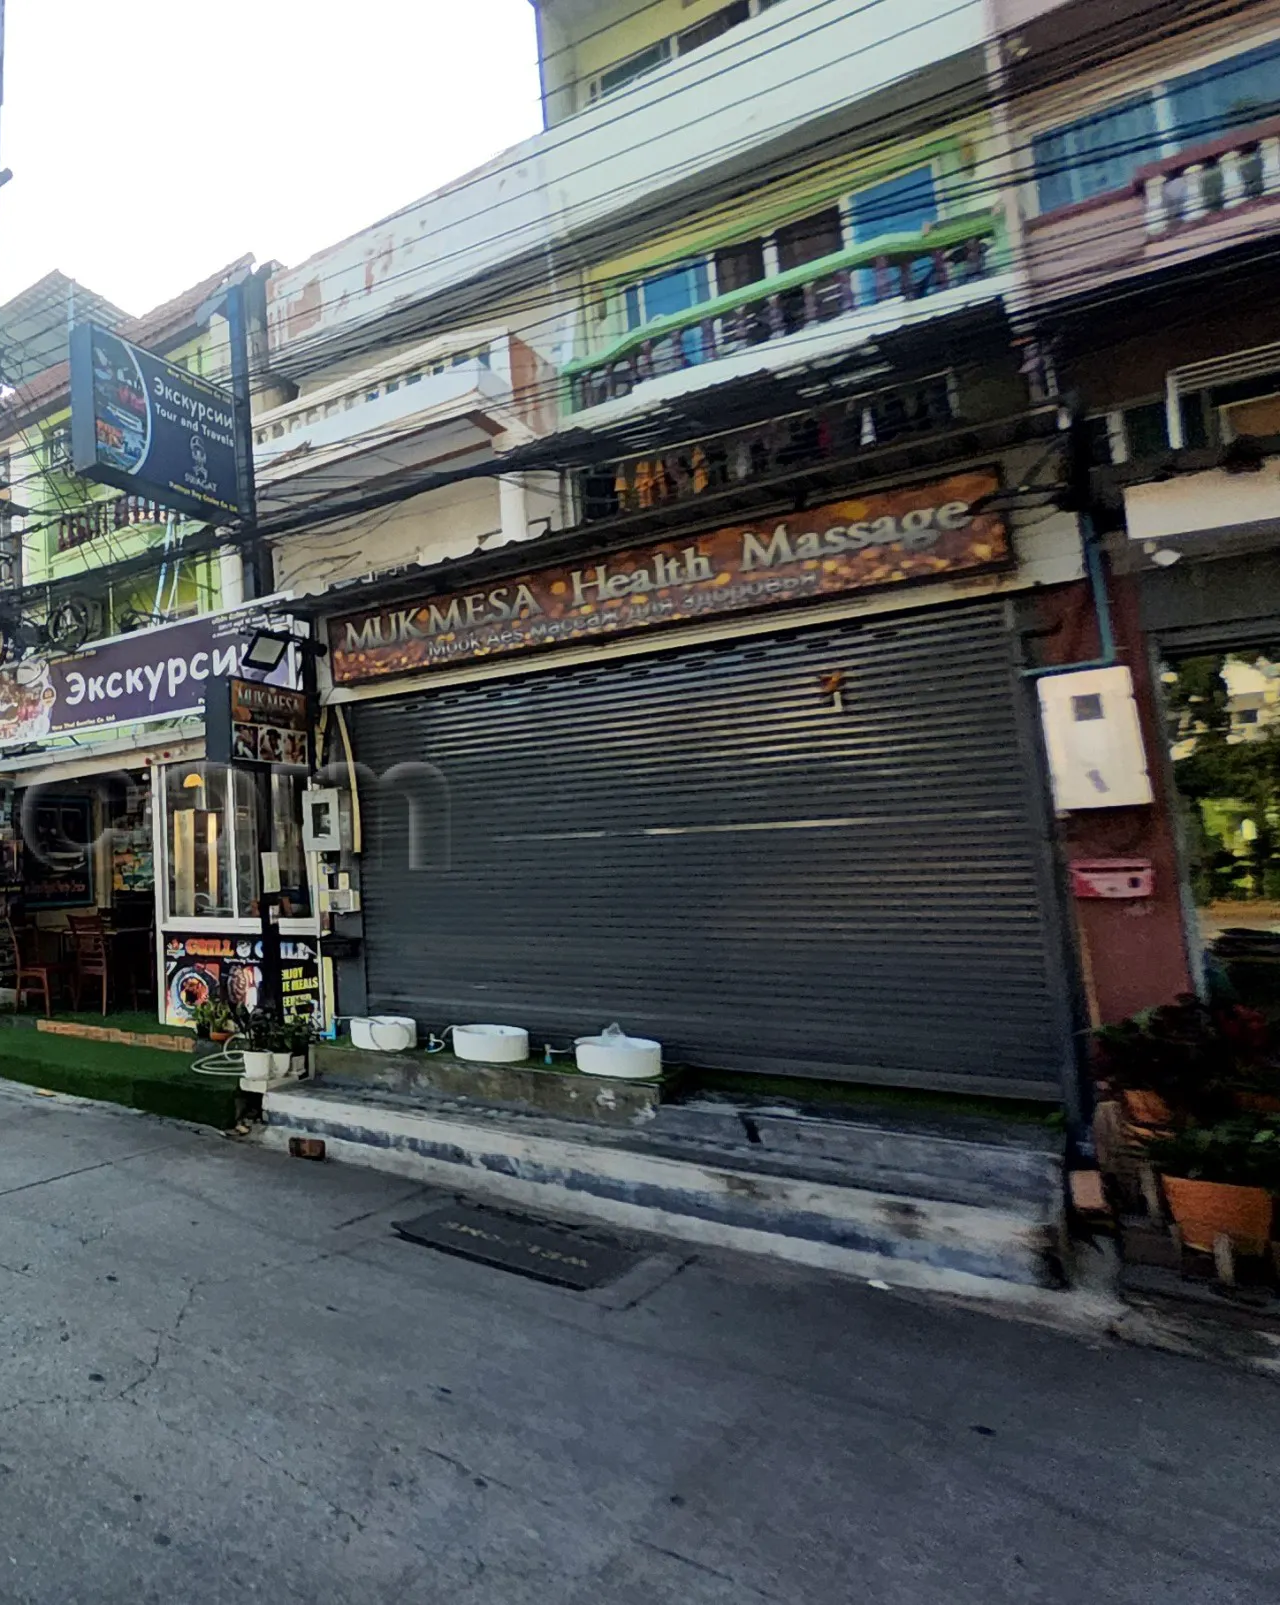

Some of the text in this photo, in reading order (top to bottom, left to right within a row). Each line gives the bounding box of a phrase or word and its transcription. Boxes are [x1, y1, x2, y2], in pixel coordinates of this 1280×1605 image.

[154, 376, 233, 430] Экскурсии
[155, 402, 234, 447] Tour and Travels
[570, 546, 716, 606] Health
[739, 500, 972, 572] Massage
[65, 643, 249, 705] Экскурси
